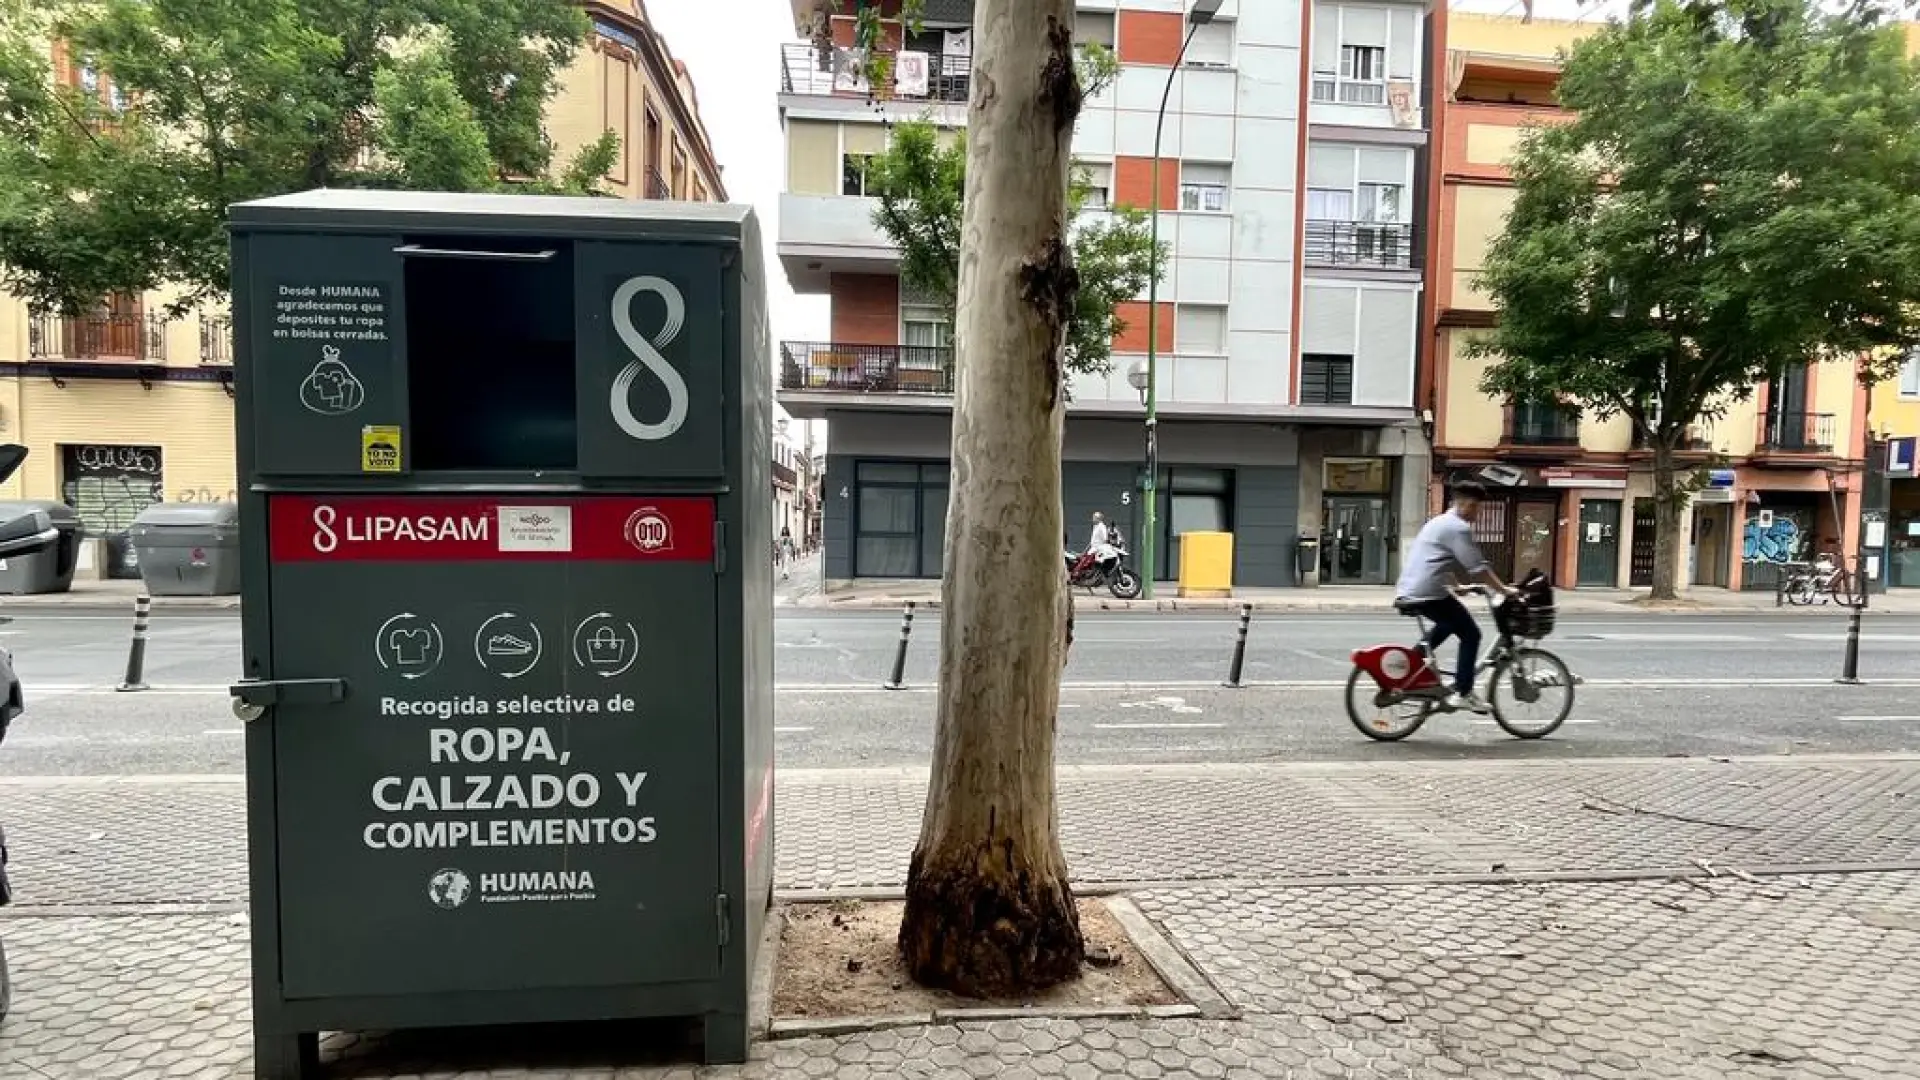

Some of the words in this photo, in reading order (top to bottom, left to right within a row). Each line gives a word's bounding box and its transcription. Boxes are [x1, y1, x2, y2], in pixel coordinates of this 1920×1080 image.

[279, 285, 316, 296] Desde
[322, 286, 380, 297] HUMANA
[277, 300, 358, 312] agradecemos
[361, 303, 384, 313] que
[277, 313, 336, 326] deposites
[340, 316, 353, 325] tu
[356, 318, 384, 328] ropa
[273, 330, 288, 338] en
[292, 328, 330, 339] bolsas
[334, 330, 389, 340] cerradas.
[840, 486, 849, 498] 4
[1122, 492, 1130, 504] 5
[347, 516, 489, 541] LIPASAM
[639, 523, 663, 541] 010
[381, 697, 489, 719] Recogida
[496, 693, 599, 714] selectiva
[607, 694, 635, 712] de
[430, 727, 571, 766] ROPA,
[372, 773, 601, 811] CALZADO
[615, 772, 648, 807] Y
[363, 817, 658, 849] COMPLEMENTOS
[481, 871, 595, 892] HUMANA
